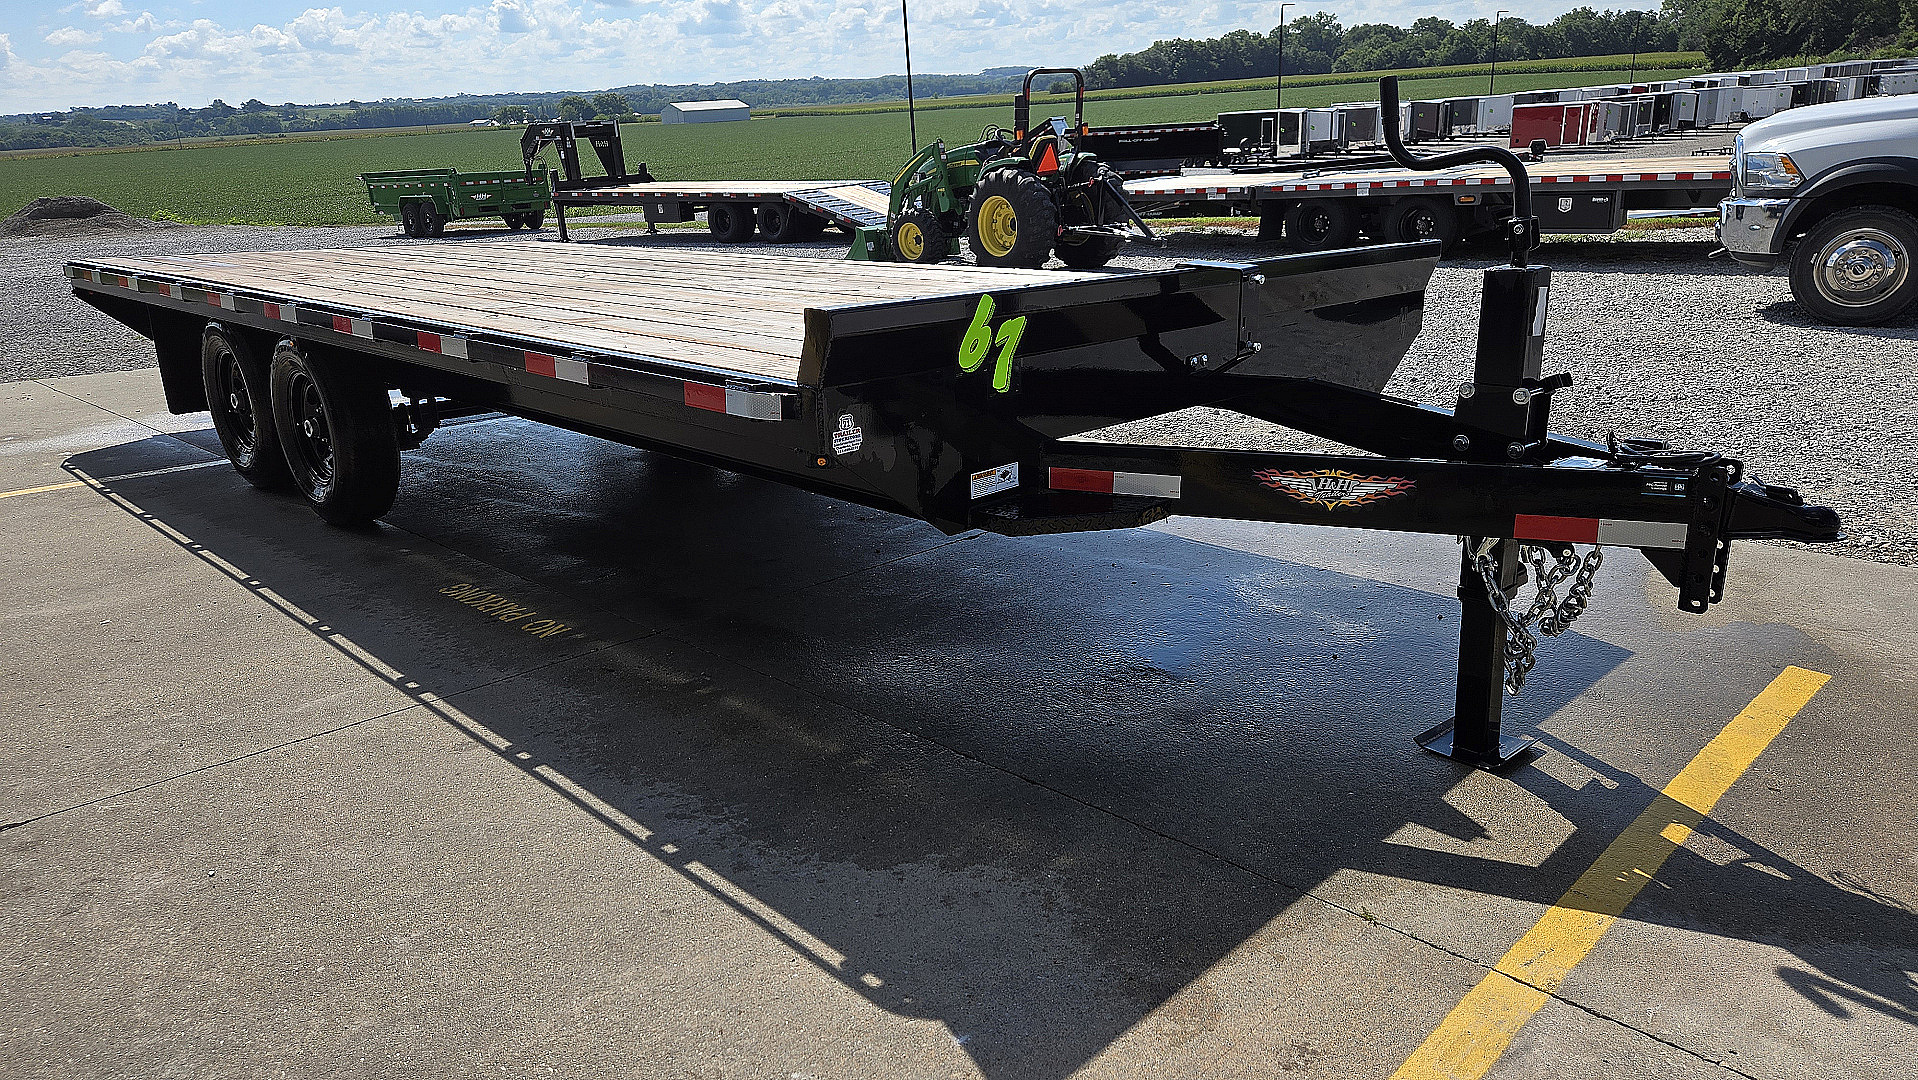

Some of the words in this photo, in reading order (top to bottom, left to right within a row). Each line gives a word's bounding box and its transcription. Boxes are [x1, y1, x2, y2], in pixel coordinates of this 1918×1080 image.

[1317, 477, 1352, 491] H&H
[438, 583, 537, 623] PARKING
[521, 619, 572, 639] NO
